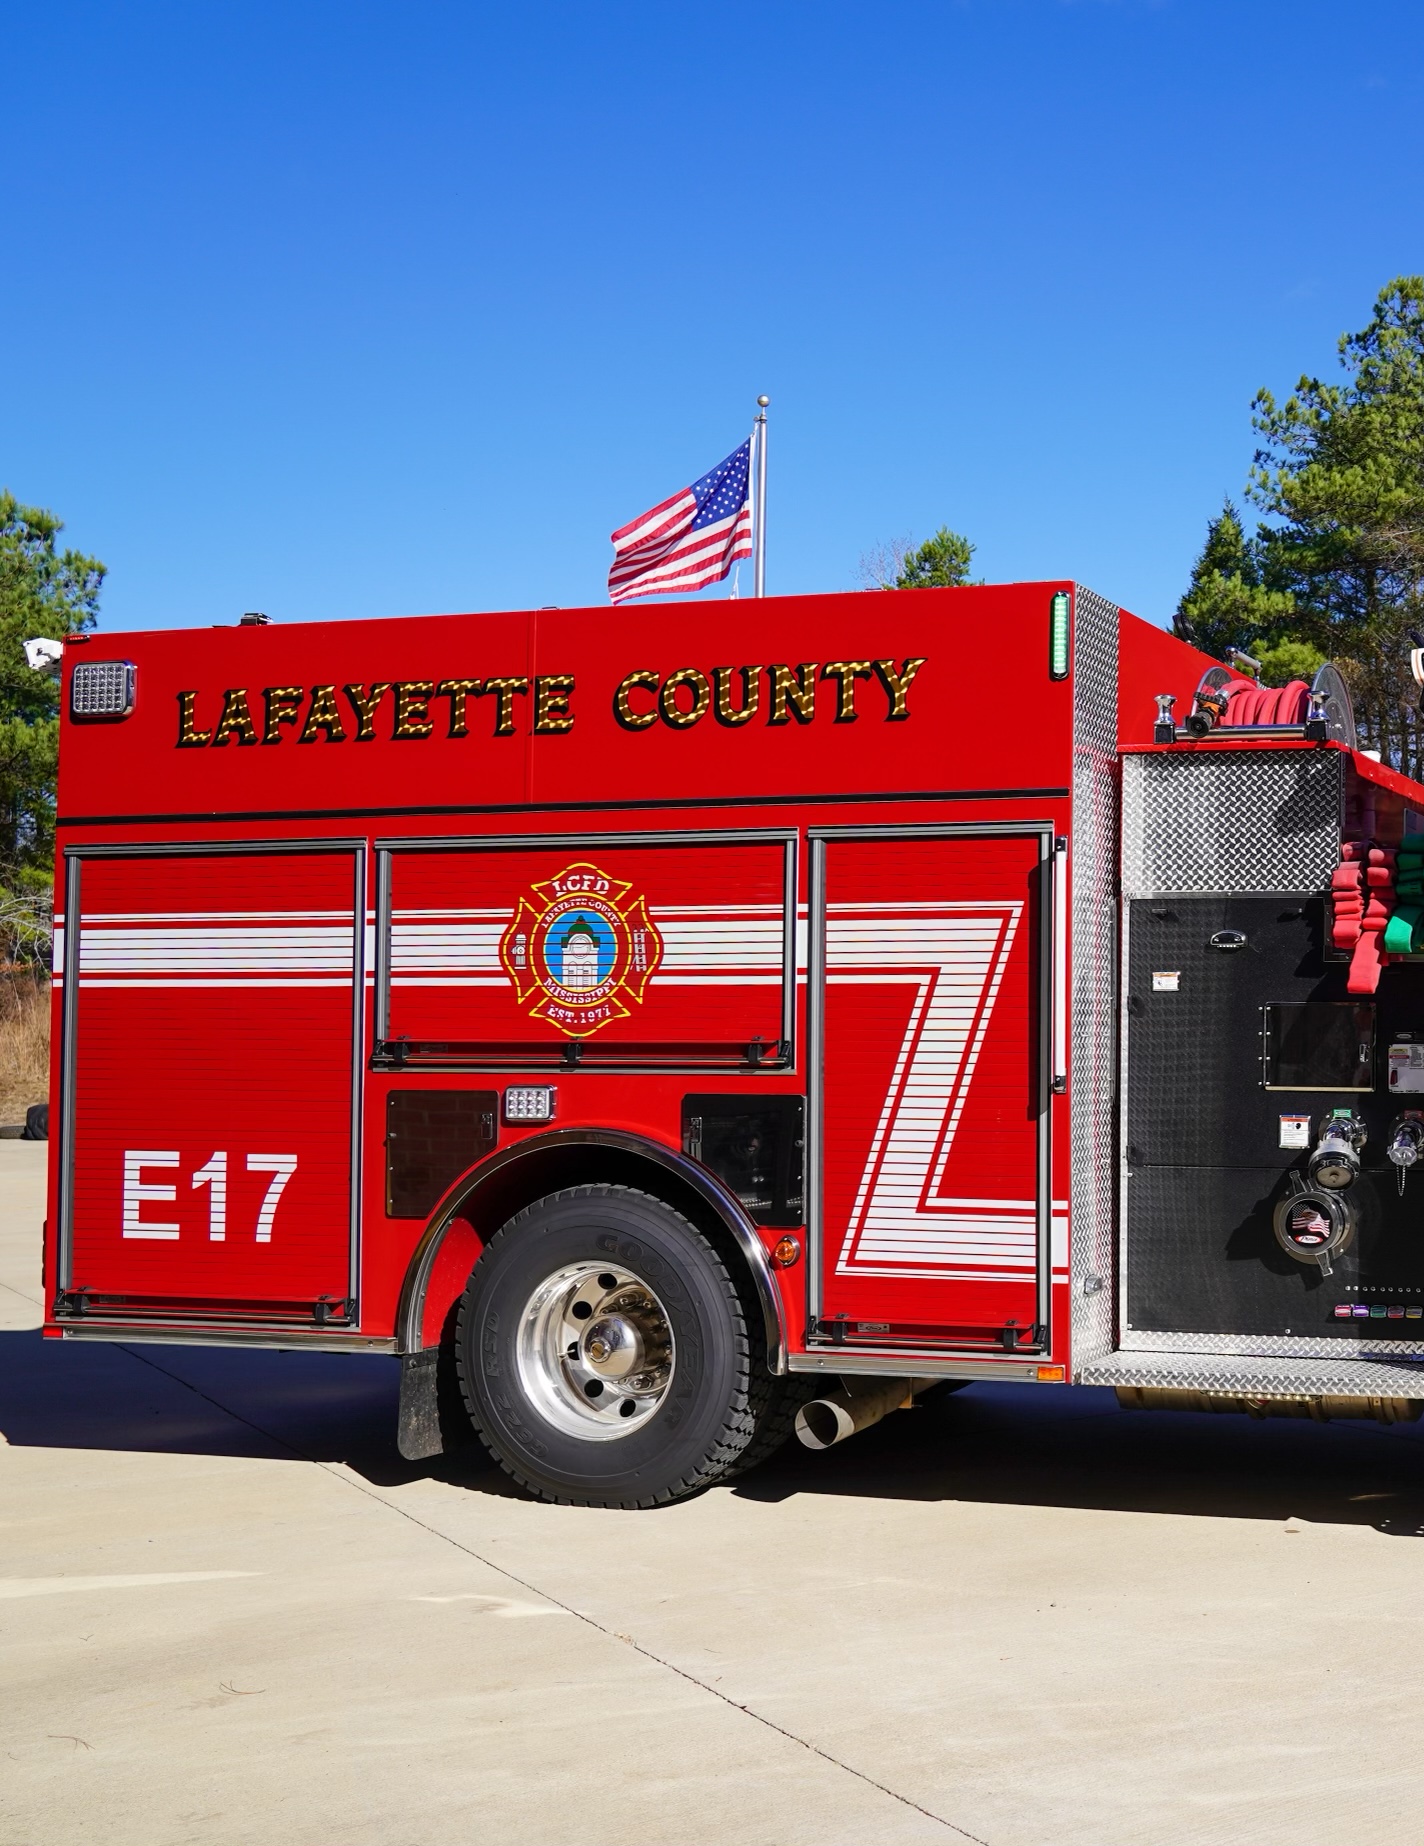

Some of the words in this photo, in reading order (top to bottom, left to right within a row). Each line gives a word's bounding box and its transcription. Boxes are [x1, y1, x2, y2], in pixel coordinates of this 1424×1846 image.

[175, 673, 576, 748] LAFAYETTE
[612, 657, 928, 732] COUNTY
[552, 874, 610, 898] LCFD
[542, 898, 588, 929] LAFAYETTE
[588, 898, 622, 928] COUNTY
[543, 977, 618, 1004] MISSISSIPPI
[547, 1004, 578, 1024] EST.
[579, 1004, 612, 1024] 1977
[121, 1150, 298, 1243] E17
[594, 1233, 700, 1431] GOODYEAR
